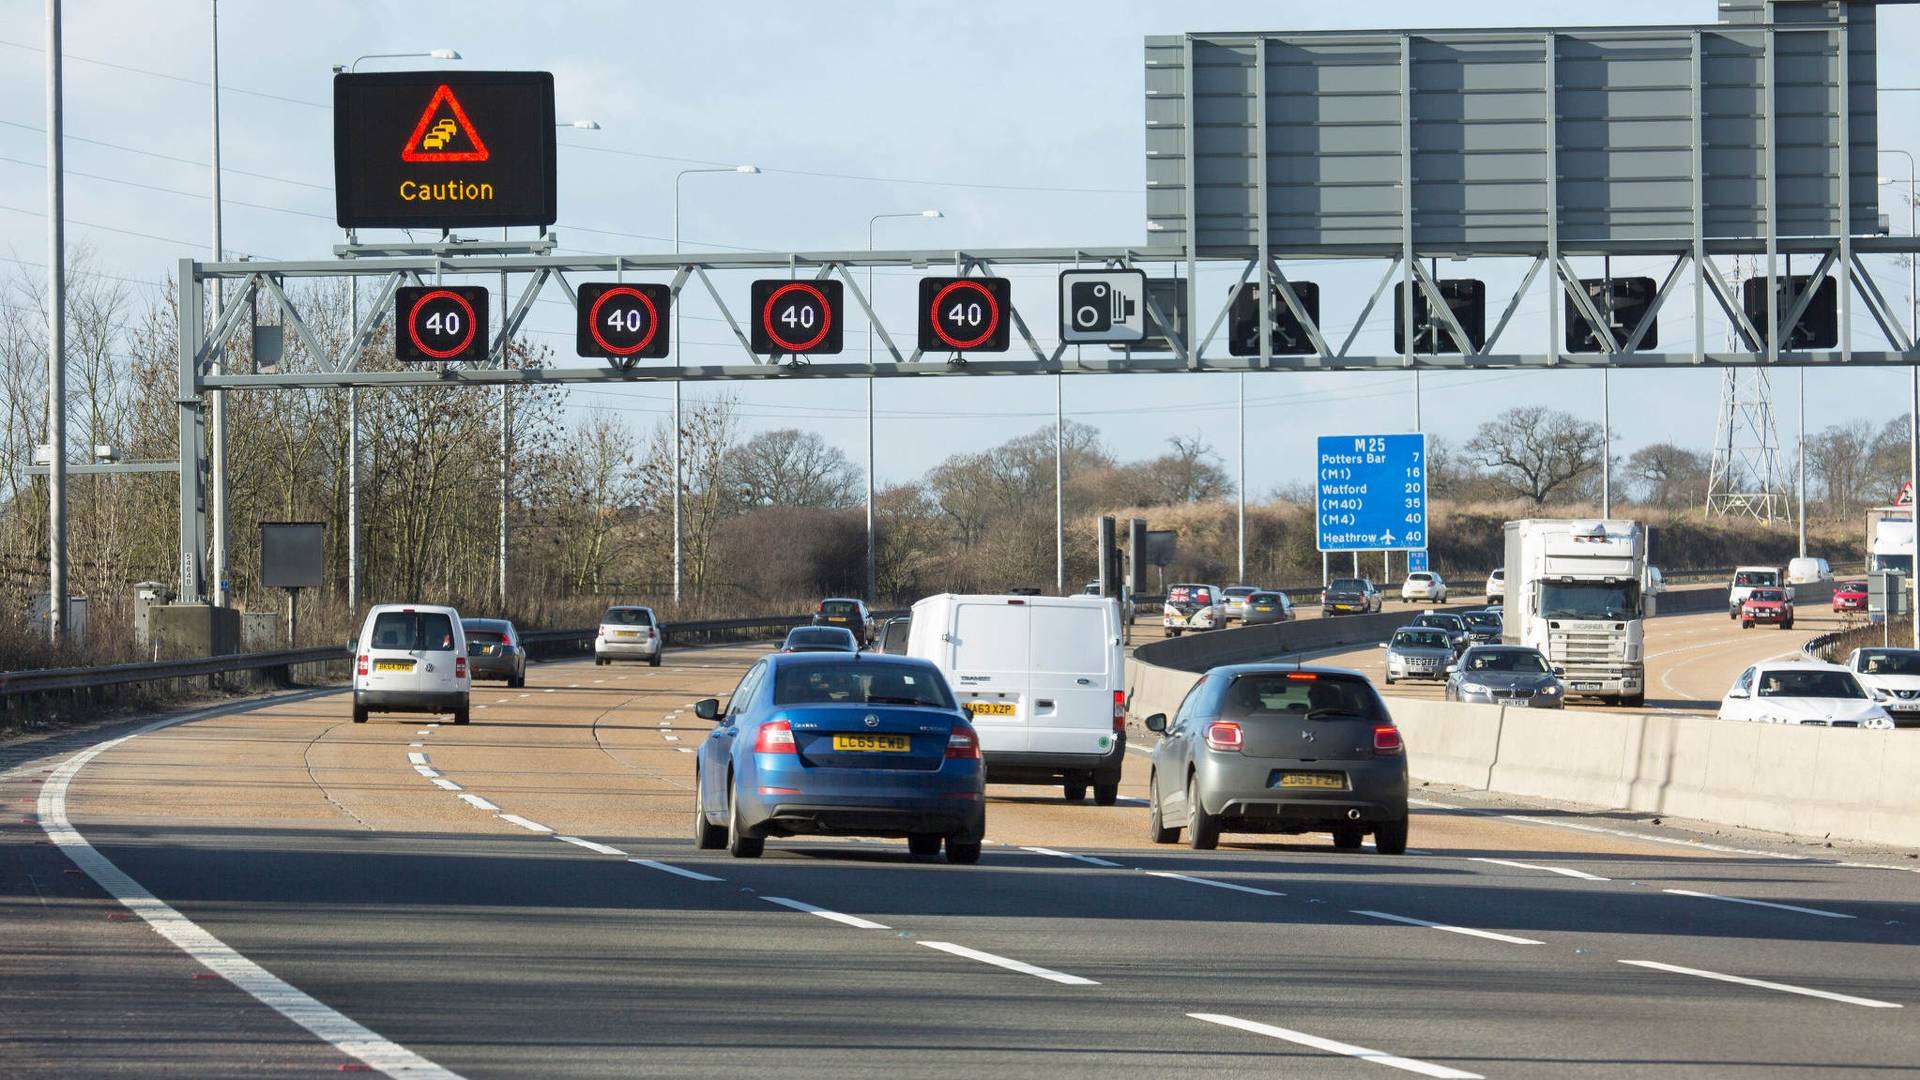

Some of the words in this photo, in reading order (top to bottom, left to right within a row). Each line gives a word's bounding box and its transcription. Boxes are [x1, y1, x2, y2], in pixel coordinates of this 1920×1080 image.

[400, 178, 493, 200] Caution
[607, 309, 641, 332] 40
[781, 305, 815, 328] 40
[949, 303, 982, 326] 40
[426, 312, 460, 335] 40
[1355, 438, 1385, 452] M25
[1322, 454, 1363, 464] Potters
[1366, 453, 1386, 463] Bar
[1413, 452, 1420, 462] 7
[1321, 468, 1351, 480] (M1)
[1406, 467, 1420, 477] 16
[1322, 484, 1367, 494] Watford
[1405, 483, 1421, 493] 20
[1322, 498, 1363, 511] (M40)
[1405, 498, 1421, 508] 35
[1322, 513, 1355, 526] (M4)
[1405, 513, 1421, 523] 40
[1323, 532, 1377, 543] Heathrow
[1406, 531, 1421, 541] 40
[993, 704, 1012, 714] XZP
[840, 735, 875, 748] LC65
